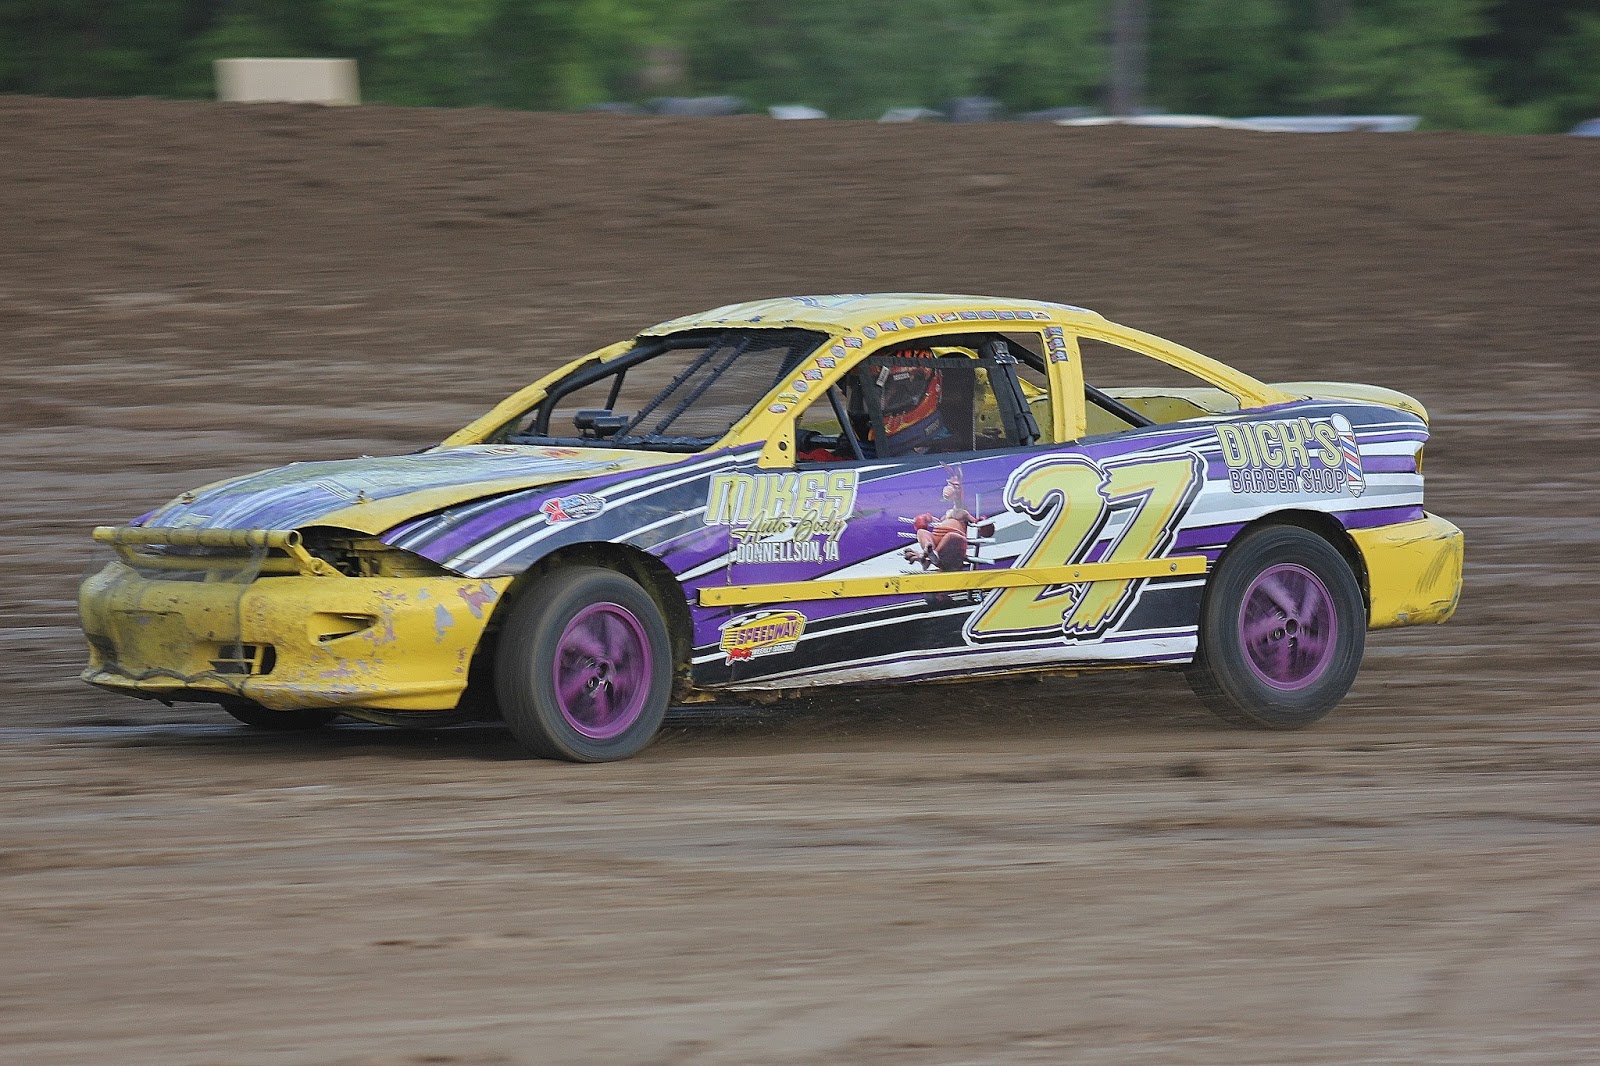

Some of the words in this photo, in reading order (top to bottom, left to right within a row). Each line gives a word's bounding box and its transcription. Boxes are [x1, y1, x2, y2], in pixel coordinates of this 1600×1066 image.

[1215, 418, 1343, 469] DICK'S
[704, 471, 858, 525] MIKES
[1230, 469, 1299, 493] BARBER
[1301, 469, 1346, 493] SHOP
[731, 510, 791, 543] Auto
[793, 509, 847, 541] Body
[736, 541, 823, 564] DONNELLSON,
[825, 541, 839, 561] IA
[965, 454, 1206, 644] 27
[737, 620, 799, 645] SPEEDWAY
